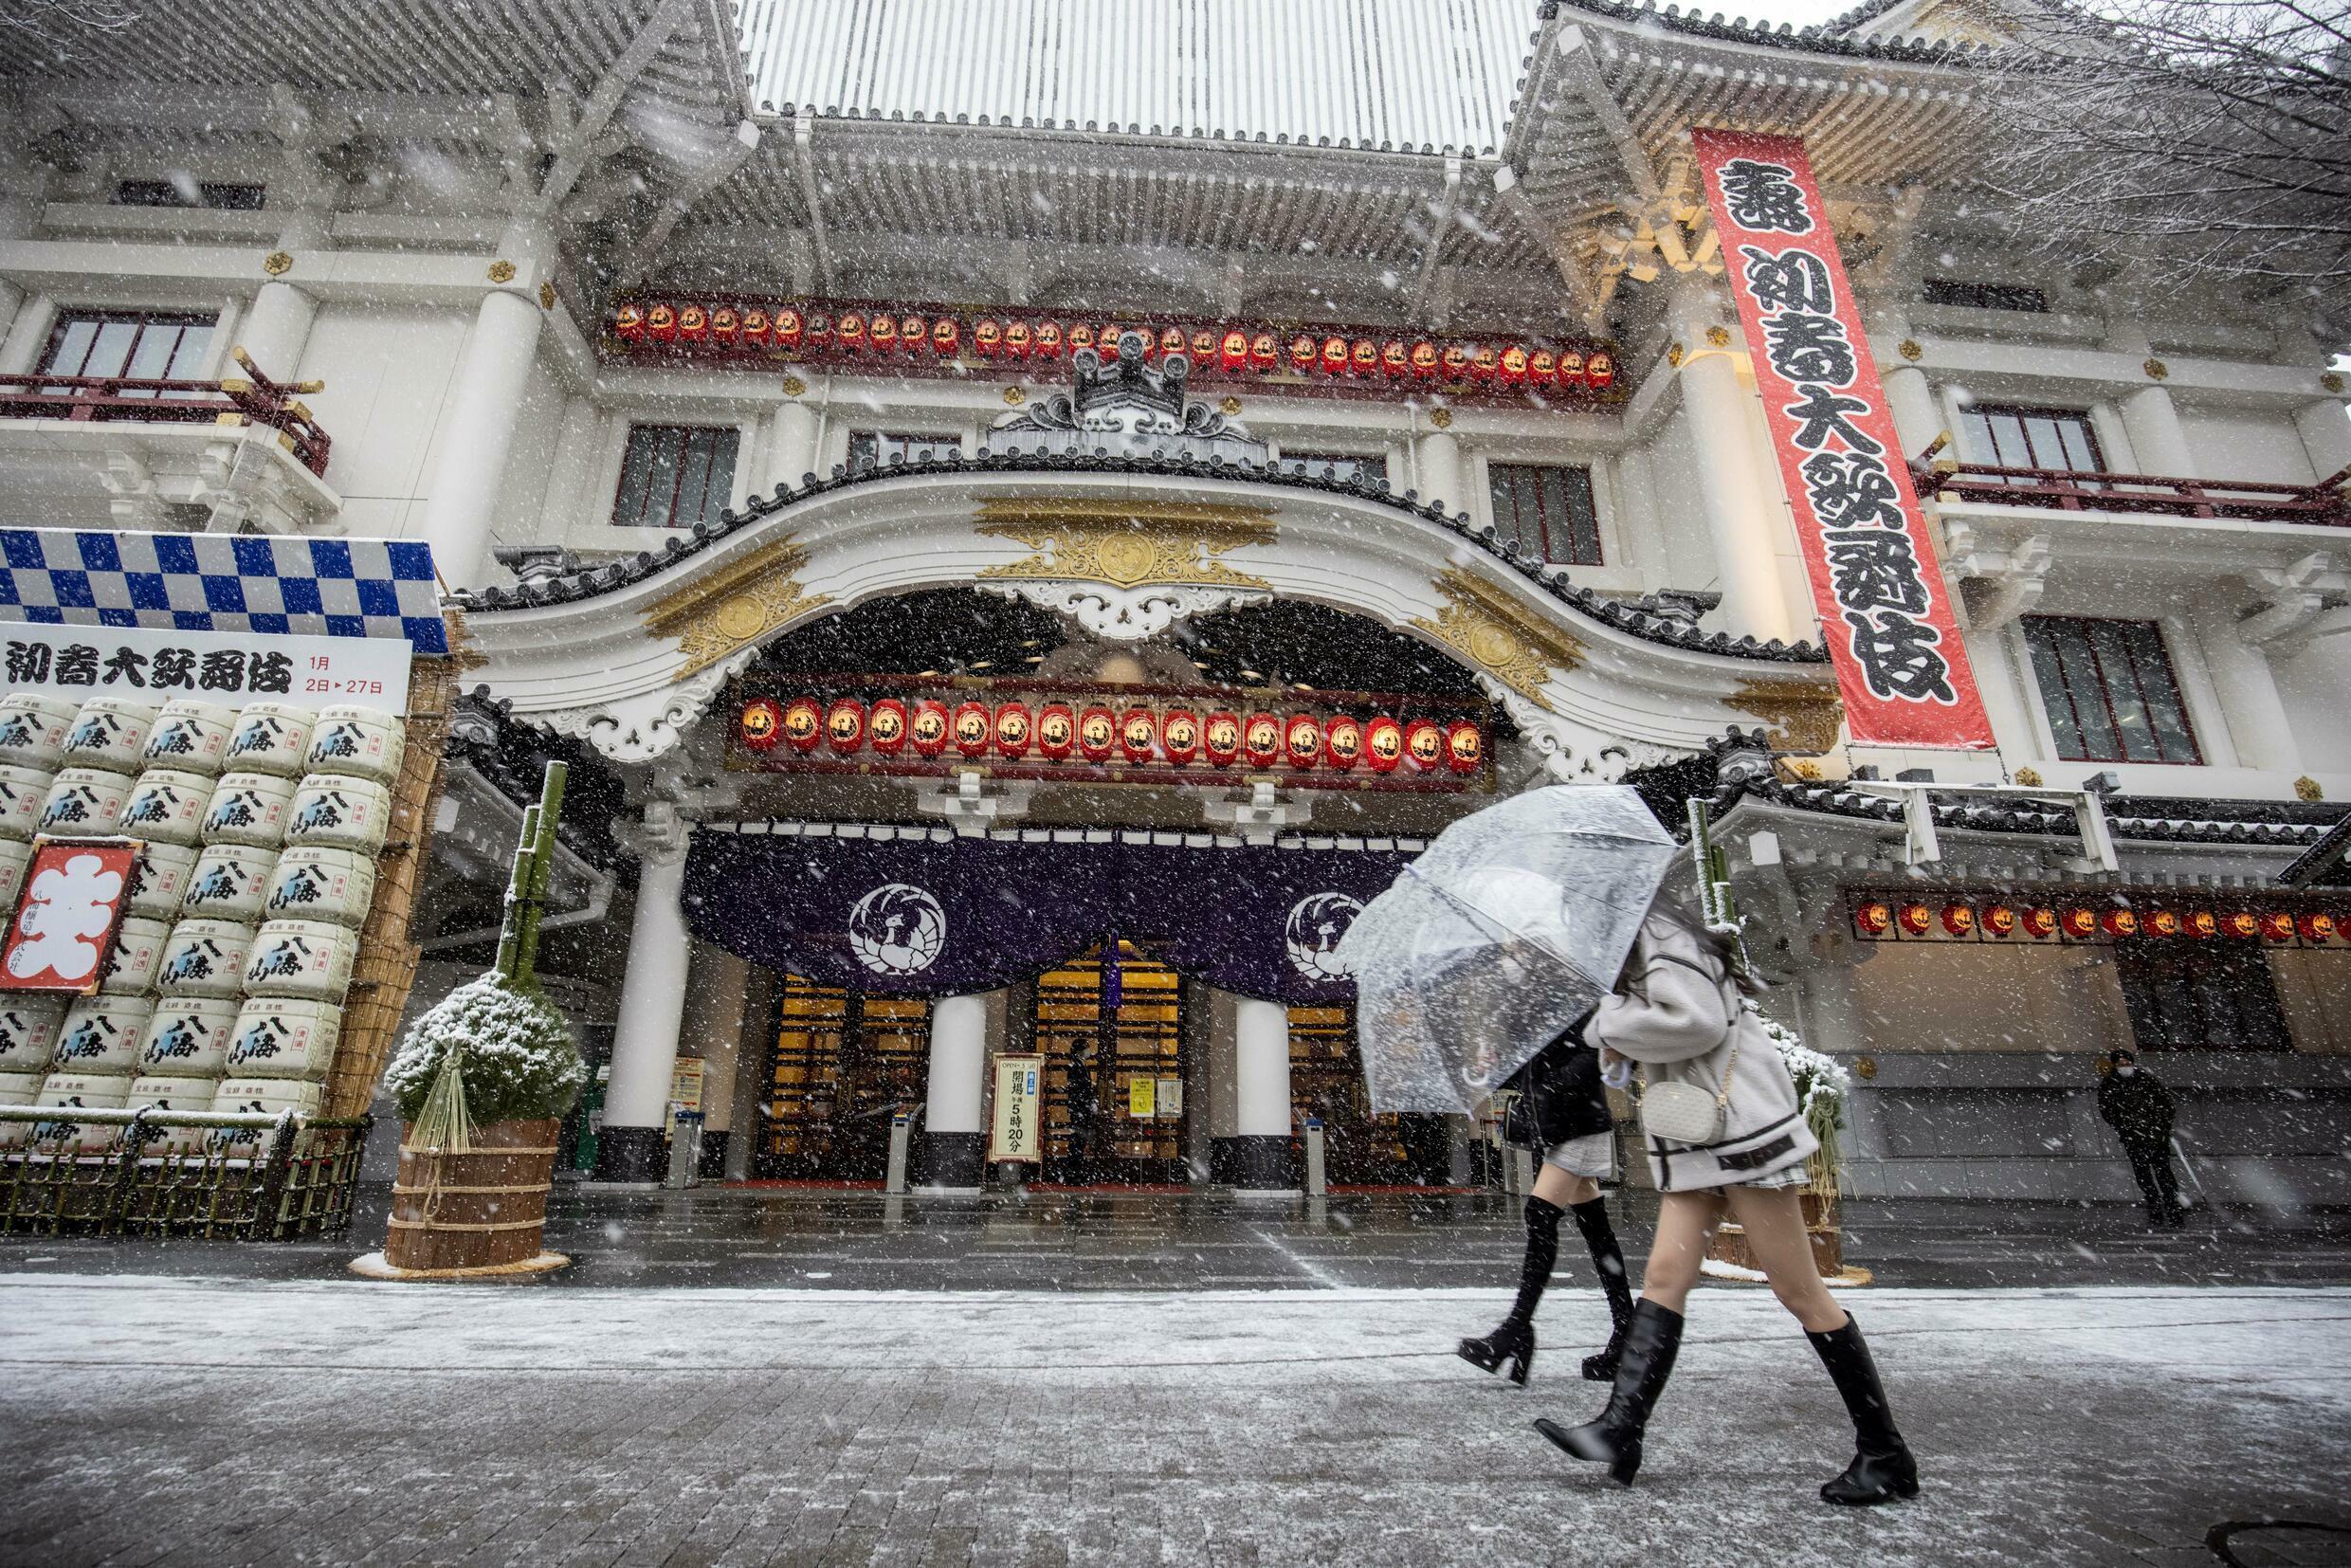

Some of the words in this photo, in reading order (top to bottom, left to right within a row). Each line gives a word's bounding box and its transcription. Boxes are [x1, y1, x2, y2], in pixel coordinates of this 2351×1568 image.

[6, 640, 293, 694] 初春大歌舞伎
[310, 655, 329, 671] 1月
[305, 678, 329, 693] 2日
[346, 680, 382, 695] 27日
